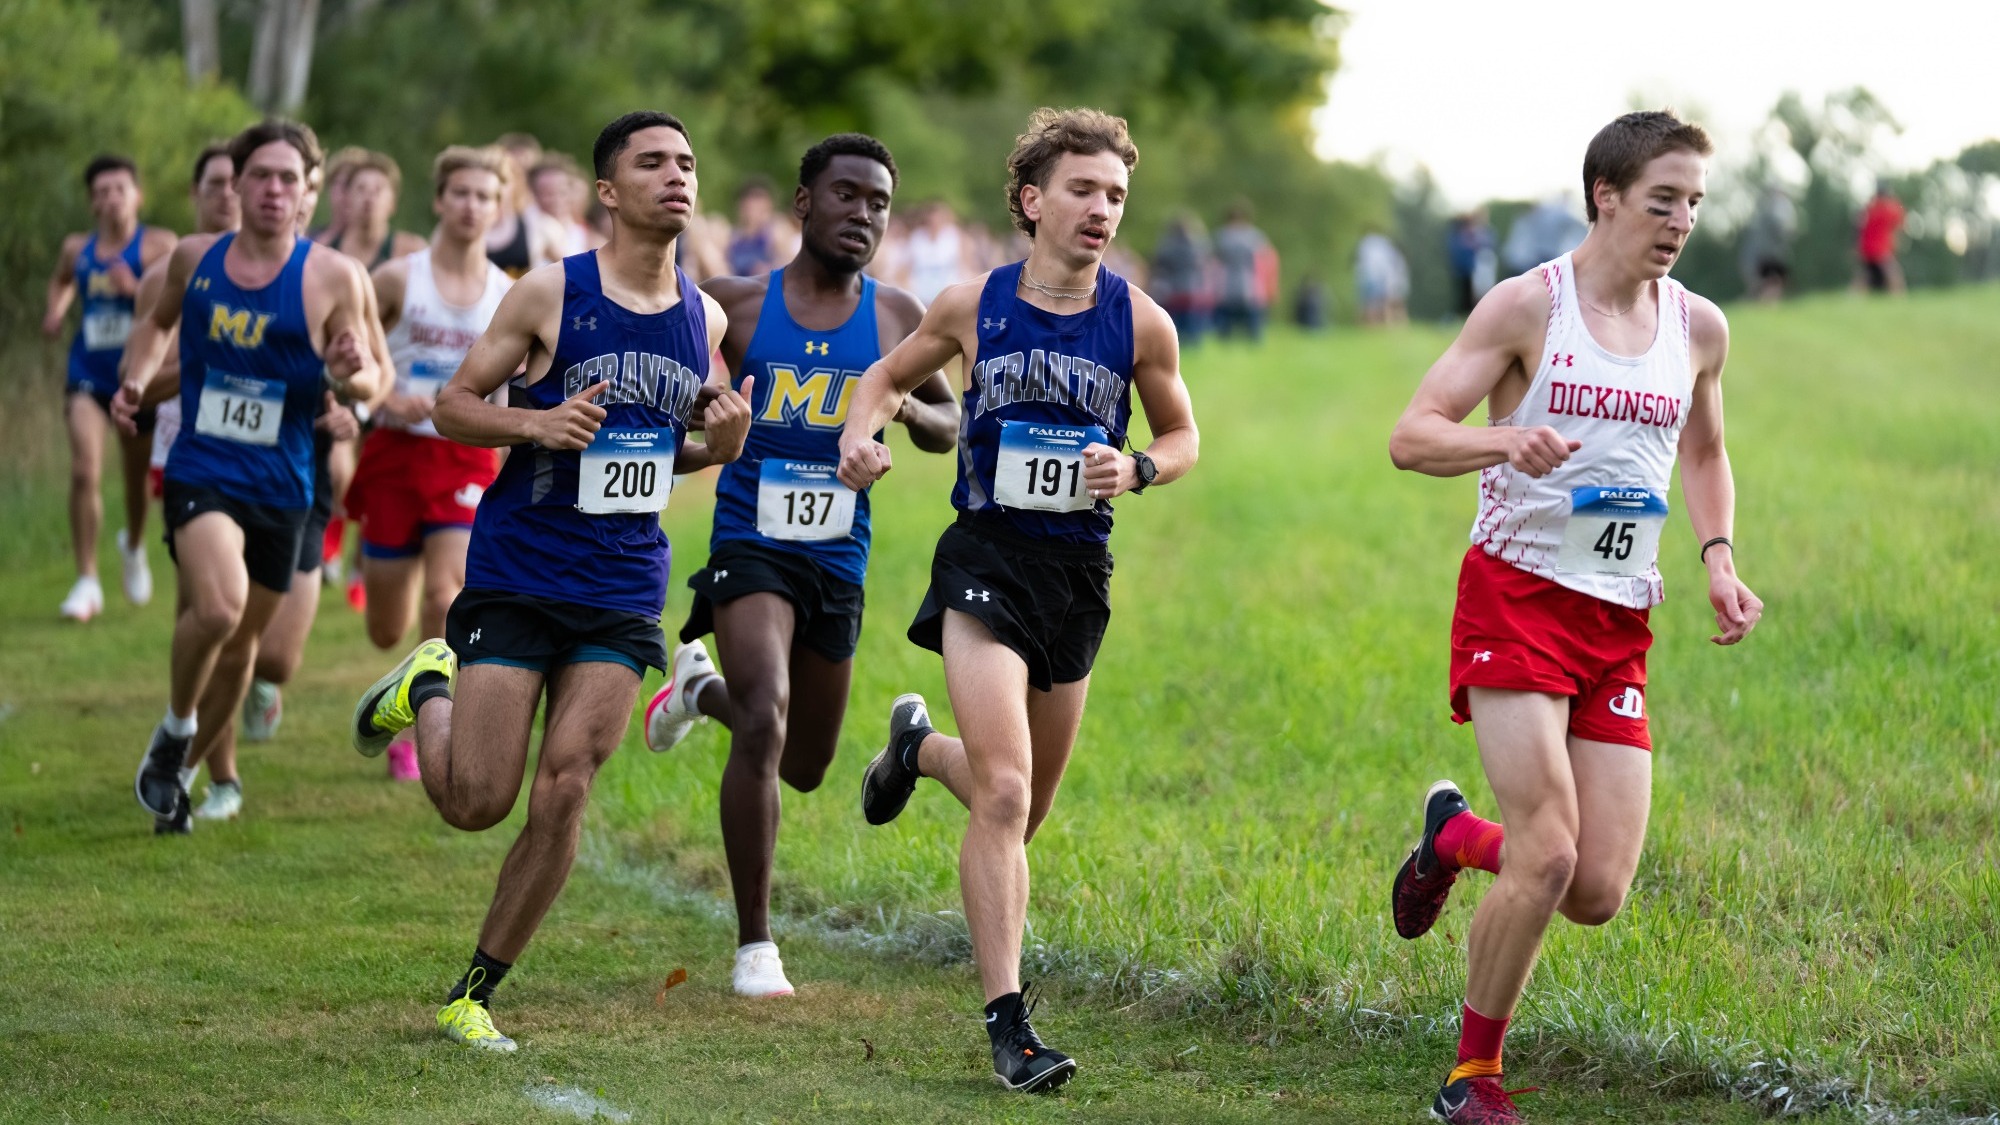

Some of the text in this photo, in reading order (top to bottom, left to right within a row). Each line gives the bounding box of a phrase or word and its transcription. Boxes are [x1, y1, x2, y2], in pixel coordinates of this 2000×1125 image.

[209, 302, 272, 348] MU
[755, 362, 865, 432] MU
[974, 349, 1126, 432] SCRANTON
[1548, 381, 1681, 429] DICKINSON
[221, 395, 264, 431] 143
[608, 432, 659, 440] FALCON
[1029, 427, 1086, 438] FALCON
[603, 461, 656, 498] 200
[784, 462, 837, 472] FALCON
[1025, 457, 1081, 498] 191
[783, 491, 835, 526] 137
[1599, 490, 1651, 499] FALCON
[1593, 521, 1637, 561] 45
